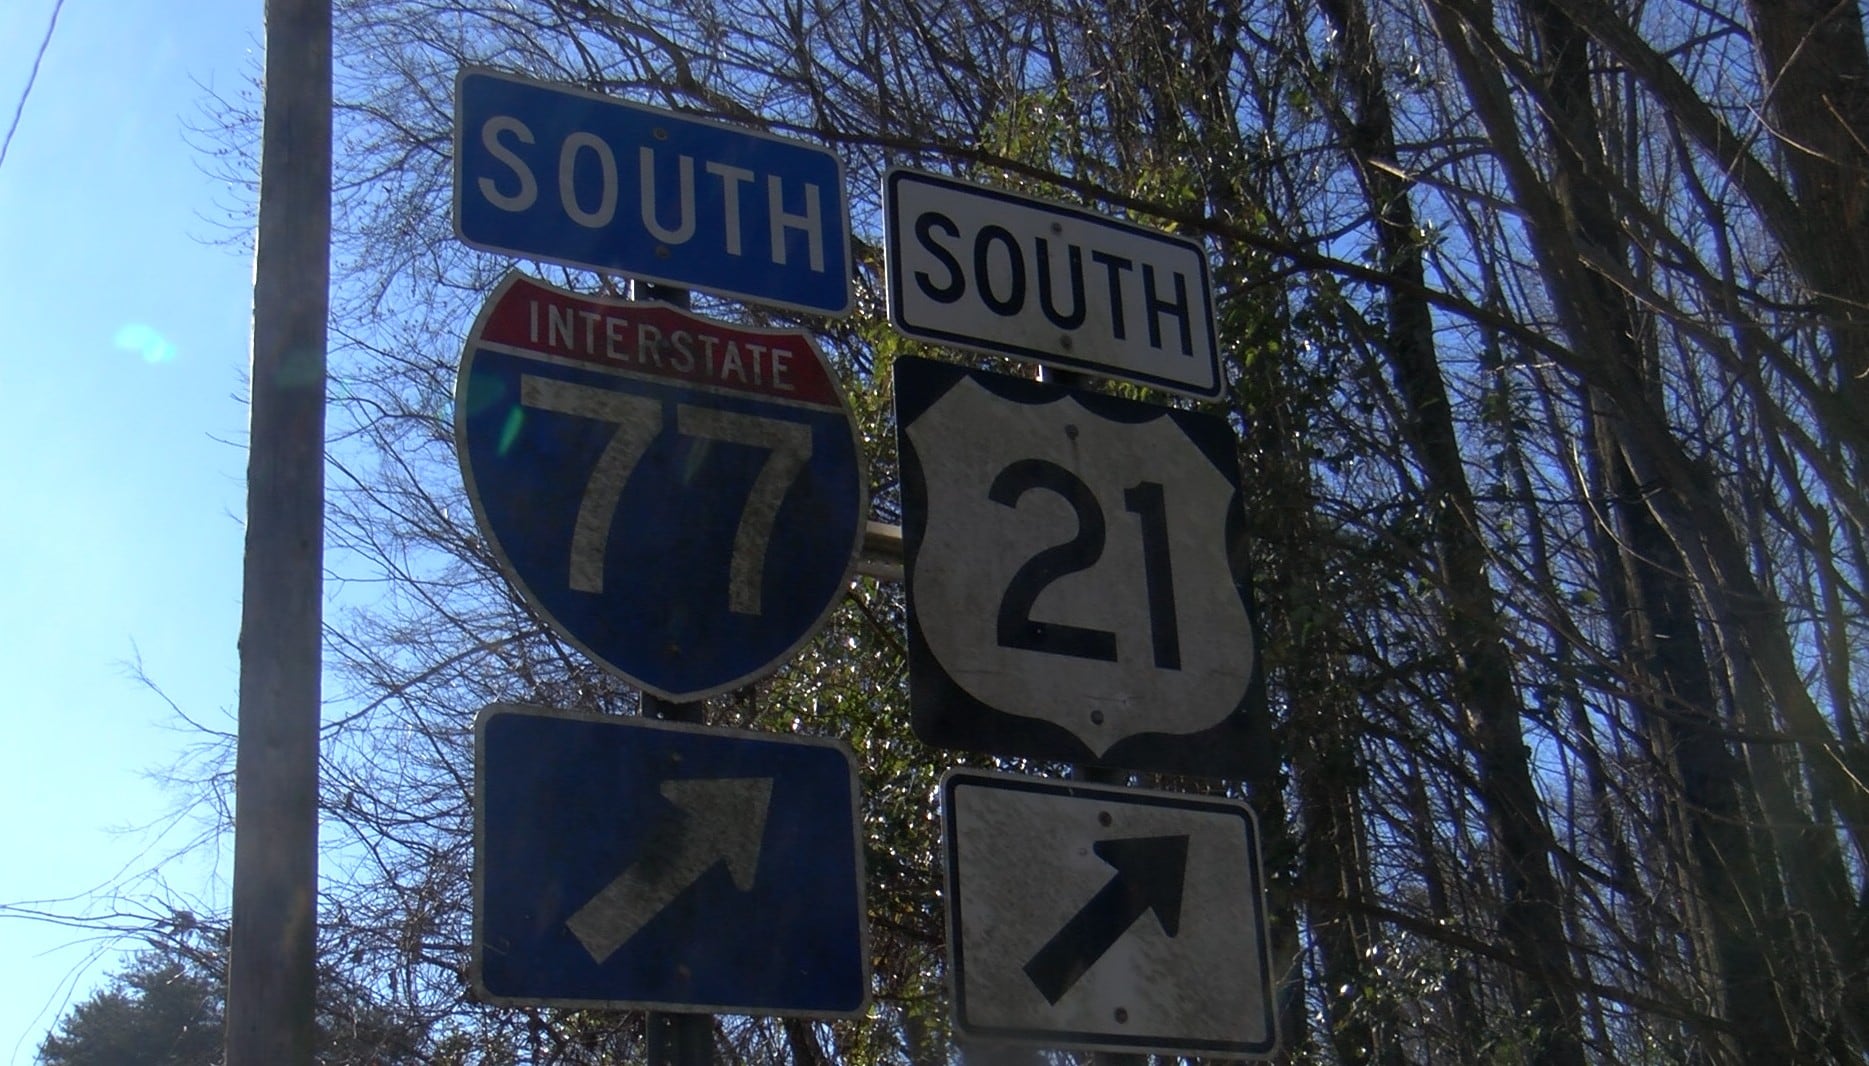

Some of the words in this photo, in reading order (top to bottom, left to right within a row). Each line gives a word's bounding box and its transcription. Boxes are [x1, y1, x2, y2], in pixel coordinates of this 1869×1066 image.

[478, 116, 825, 273] SOUTH
[527, 299, 795, 391] INTERSTATE
[914, 212, 1193, 357] SOUTH
[520, 374, 813, 615] 77
[989, 458, 1182, 670] 21
